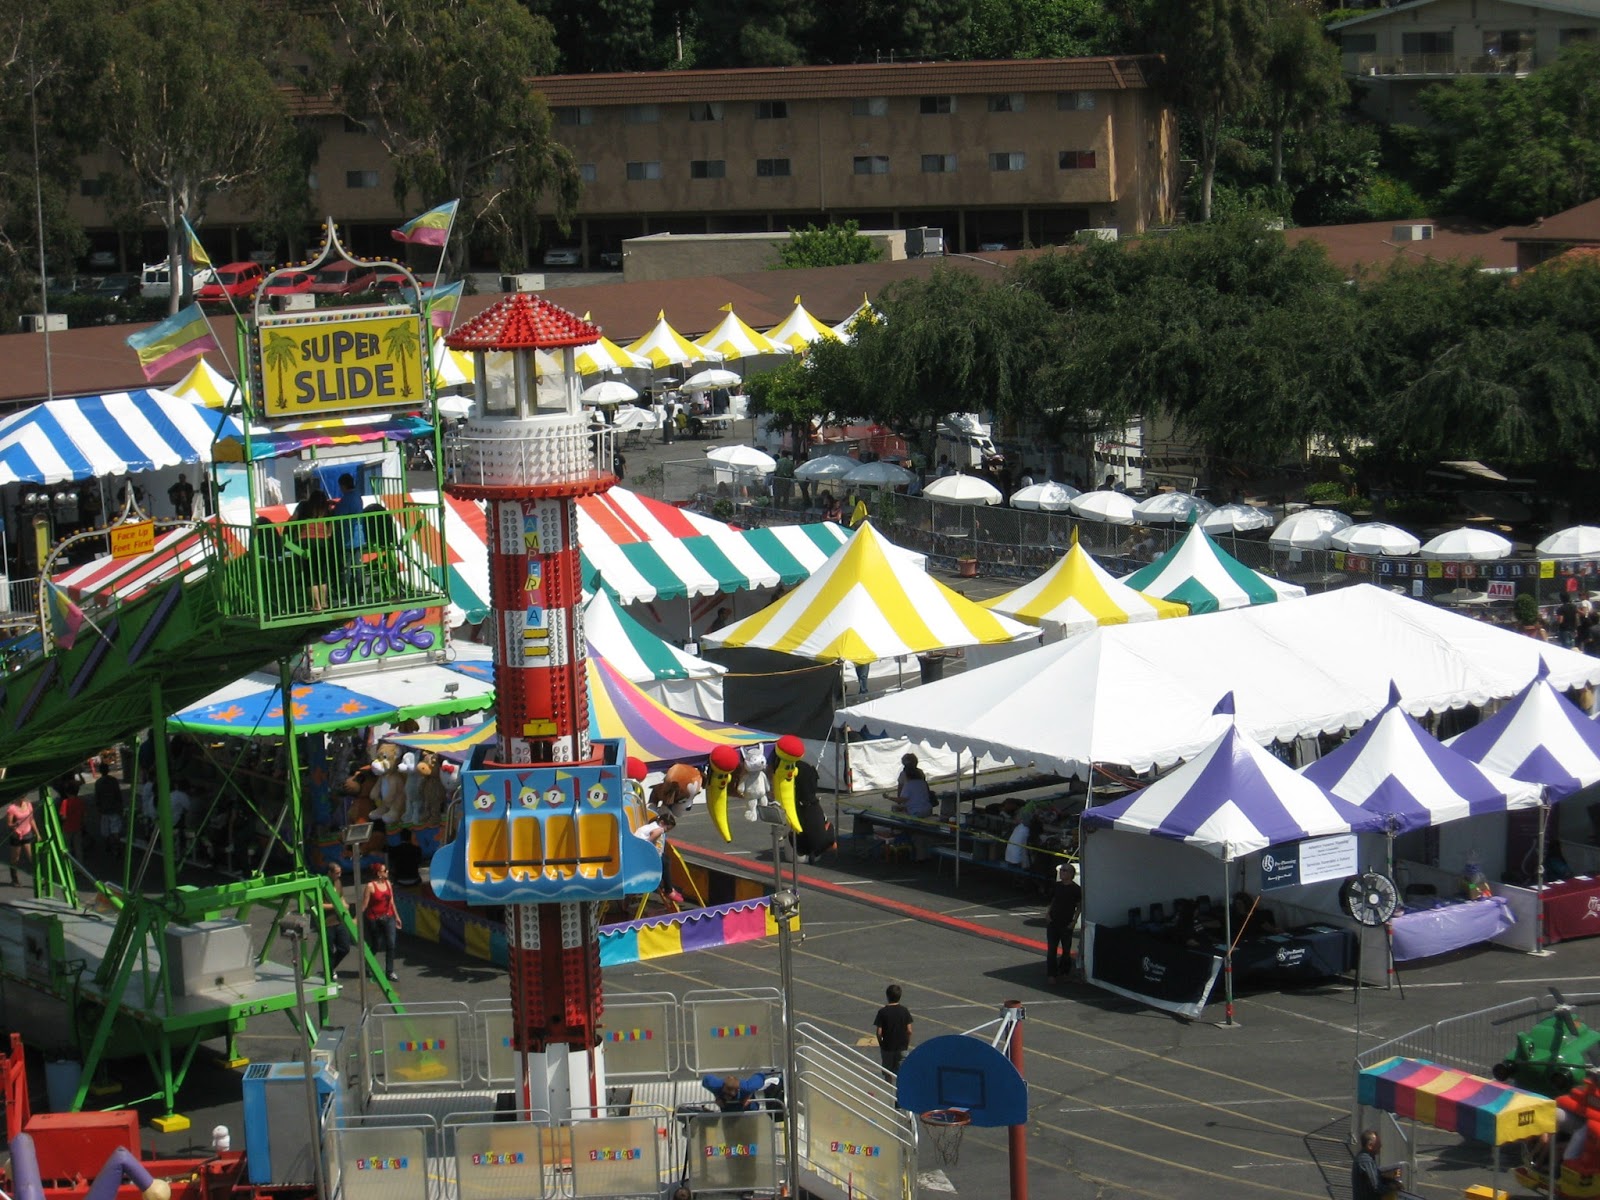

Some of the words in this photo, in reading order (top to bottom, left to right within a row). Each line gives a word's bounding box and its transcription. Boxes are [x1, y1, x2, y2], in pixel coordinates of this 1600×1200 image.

[301, 330, 380, 364] SUPER
[294, 363, 396, 404] SLIDE
[117, 532, 135, 540] Face
[113, 544, 130, 552] Feet
[134, 539, 152, 548] First
[523, 501, 541, 624] ZAMPERLA
[1489, 584, 1512, 596] ATM
[481, 798, 488, 806] 5
[526, 795, 533, 803] 6
[1518, 1110, 1535, 1127] EXIT
